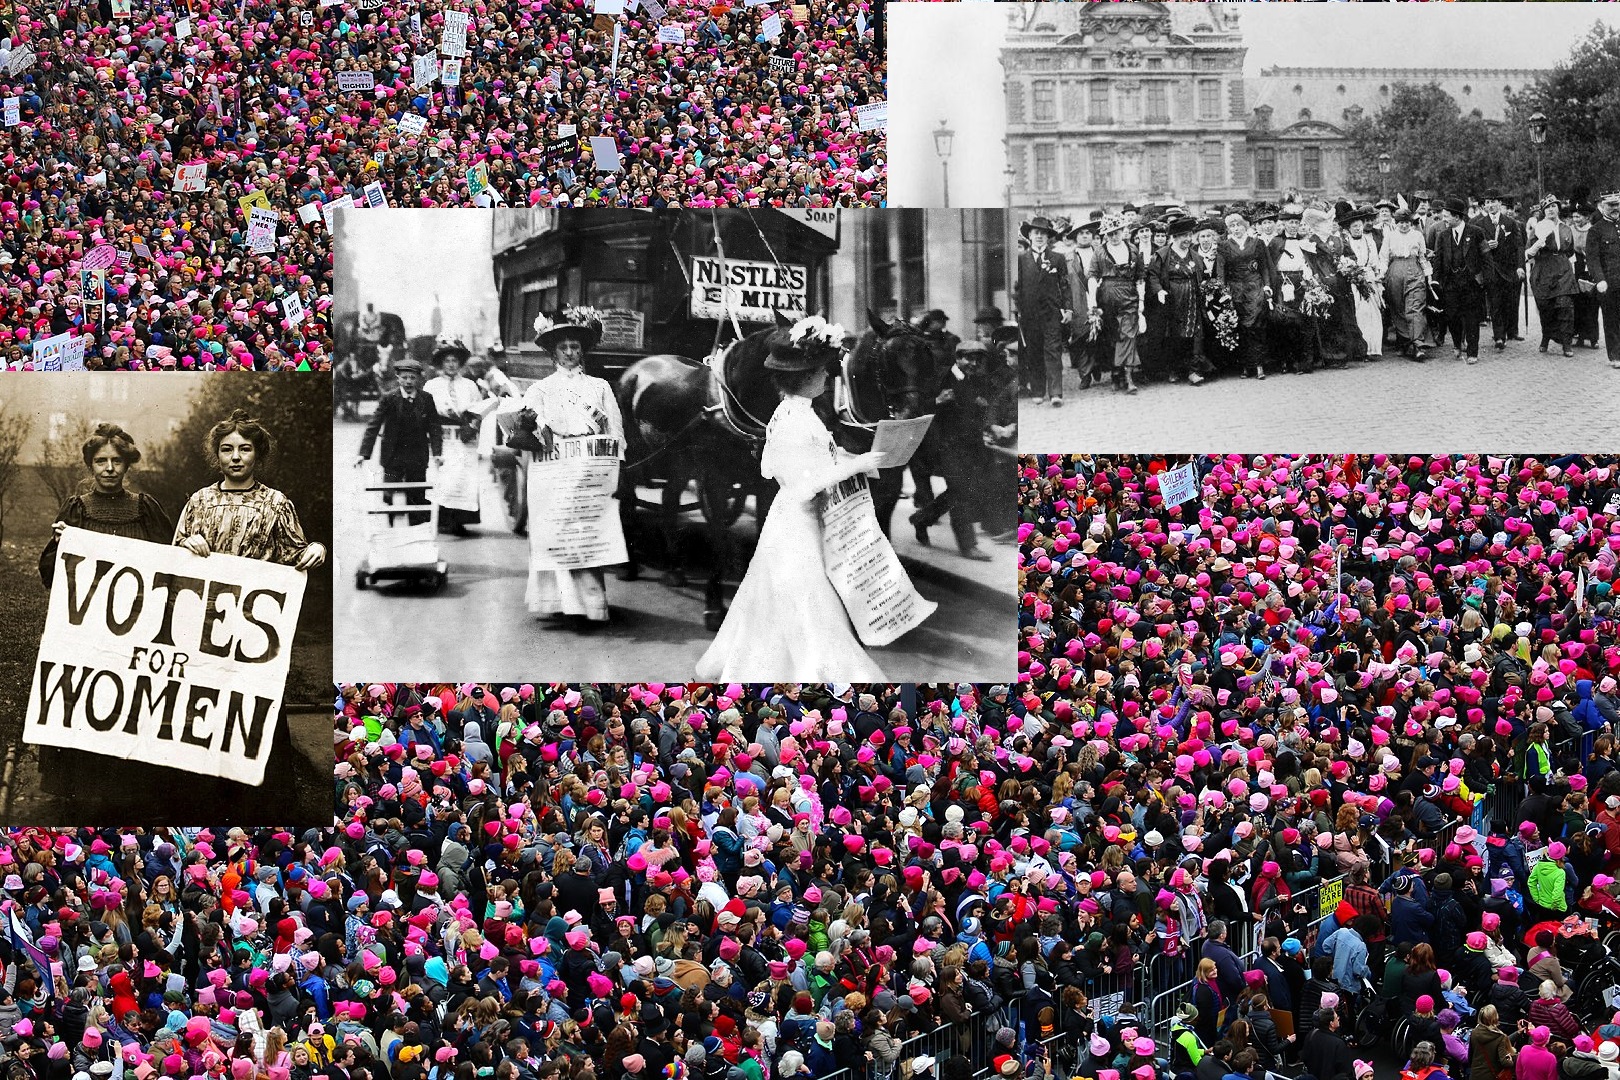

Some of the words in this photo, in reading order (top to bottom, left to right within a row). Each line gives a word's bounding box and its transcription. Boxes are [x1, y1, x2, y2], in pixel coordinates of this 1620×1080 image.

[768, 57, 795, 66] FUTURE
[556, 140, 570, 148] with
[741, 290, 806, 311] MILK
[1161, 469, 1187, 485] SILENCE
[61, 552, 287, 663] VOTES
[128, 646, 189, 678] FOR
[37, 661, 275, 760] WOMEN
[1321, 889, 1341, 904] CARE
